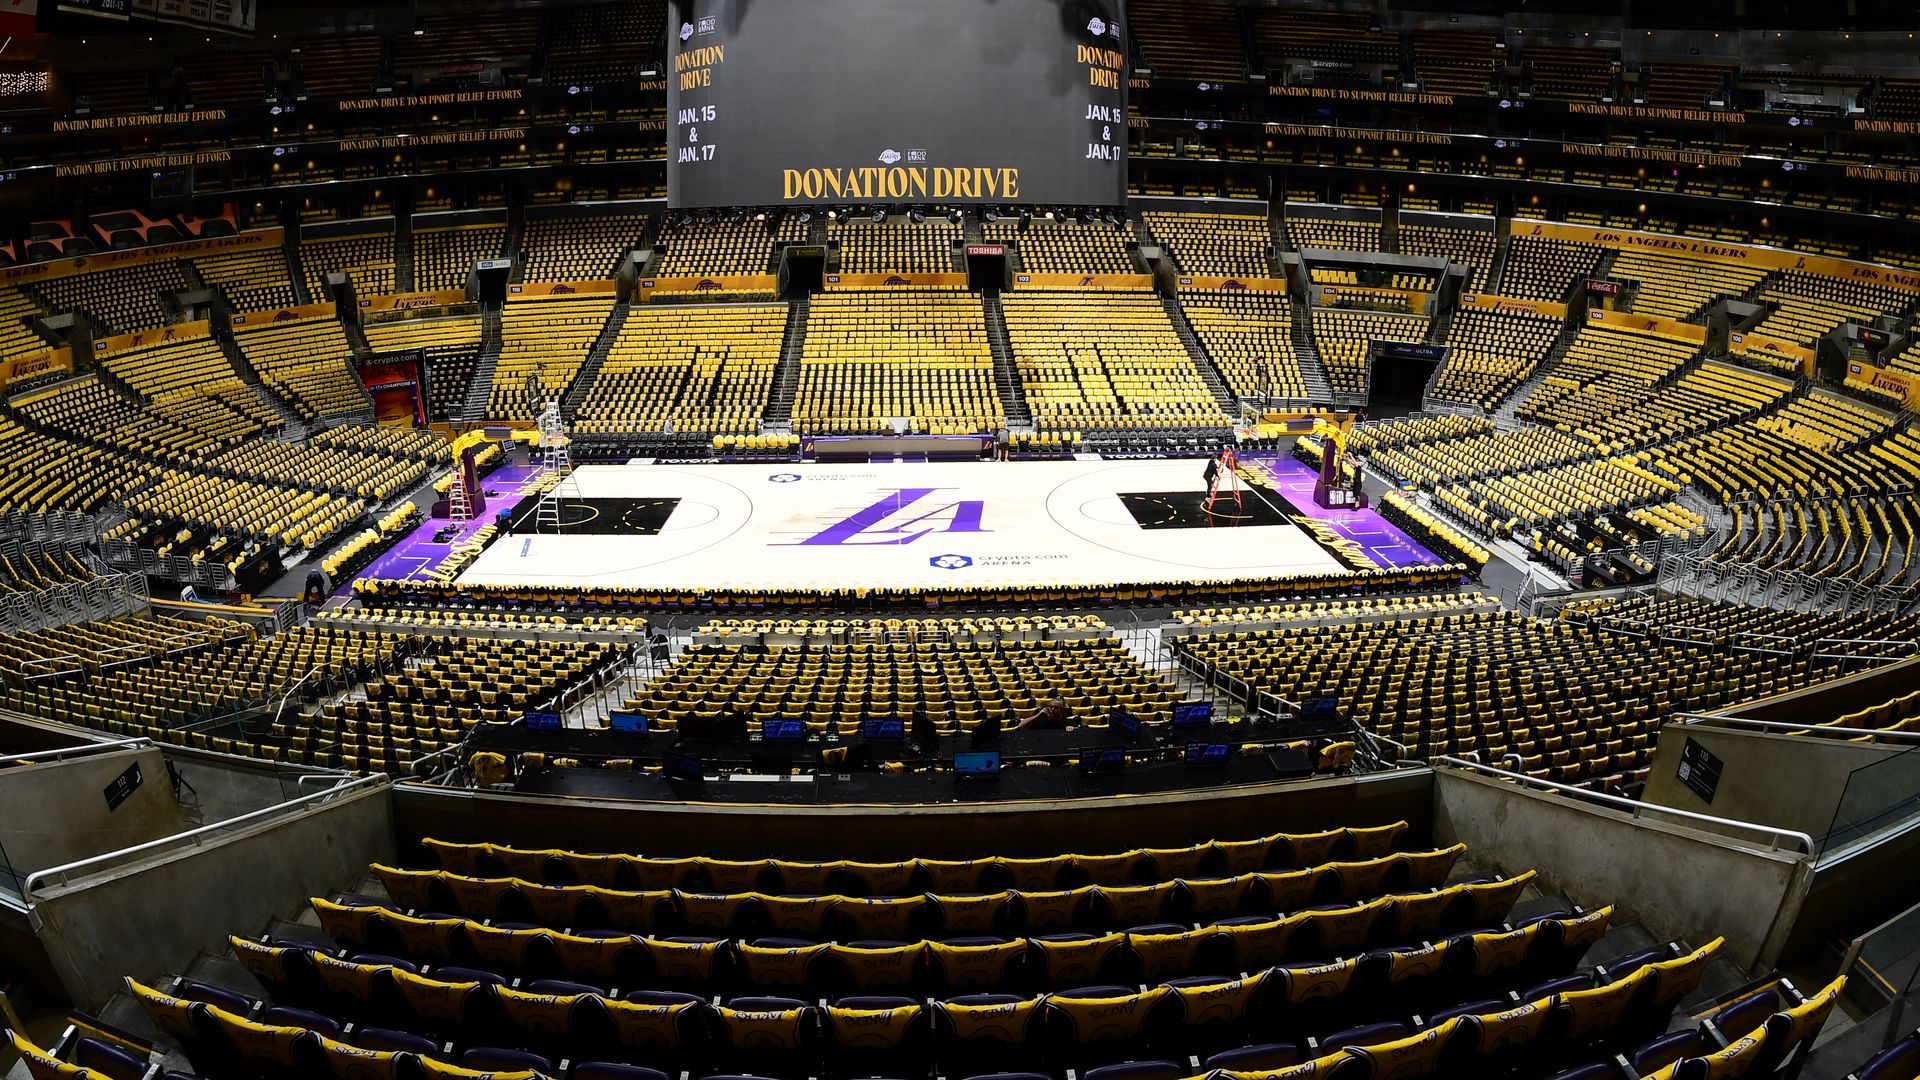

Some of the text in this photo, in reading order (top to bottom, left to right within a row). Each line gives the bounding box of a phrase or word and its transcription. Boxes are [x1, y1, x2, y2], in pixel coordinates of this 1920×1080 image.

[674, 45, 724, 72] DONATION
[1077, 44, 1124, 71] DONATION
[640, 80, 667, 91] DONAT
[680, 68, 711, 91] DRIVE
[1090, 67, 1119, 90] DRIVE
[1128, 79, 1150, 88] ORTS
[340, 89, 522, 110] DONATION DRIVE TO SUPPORT RELIEF EFFORTS
[1269, 86, 1454, 106] DONATION DRIVE TO SUPPORT RELIEF EFFORTS
[54, 109, 226, 132] DONATION DRIVE TO SUPPORT RELIEF EFFORTS
[678, 105, 716, 126] JAN. 15
[1086, 104, 1120, 124] JAN. 15
[1128, 118, 1150, 128] ORTS
[1569, 103, 1746, 124] DONATION DRIVE TO SUPPORT RELIEF EFFORTS
[688, 126, 698, 142] &
[1102, 125, 1111, 142] &
[1265, 125, 1452, 145] DONATION DRIVE TO SUPPORT RELIEF EFFORTS
[1854, 120, 1892, 132] DONATION
[1893, 122, 1916, 134] DRIVE
[340, 130, 525, 151] DONATION DRIVE TO SUPPORT RELIEF EFFORTS
[678, 145, 716, 164] JAN. 17
[1086, 143, 1120, 161] JAN. 17
[1562, 144, 1742, 168] DONATION DRIVE TO SUPPORT RELIEF EFFORTS
[56, 152, 231, 178] DONATION DRIVE TO SUPPORT RELIEF EFFORTS
[1846, 167, 1883, 180] DONATION
[1885, 170, 1908, 183] DRIVE
[783, 167, 1020, 199] DONATION DRIVE
[1594, 232, 1748, 258] LOS ANGELES LAKERS
[1852, 268, 1880, 280] LOS
[374, 354, 418, 364] crypto.com
[382, 381, 411, 389] CHAMPIONS
[978, 554, 1070, 562] crypto.com
